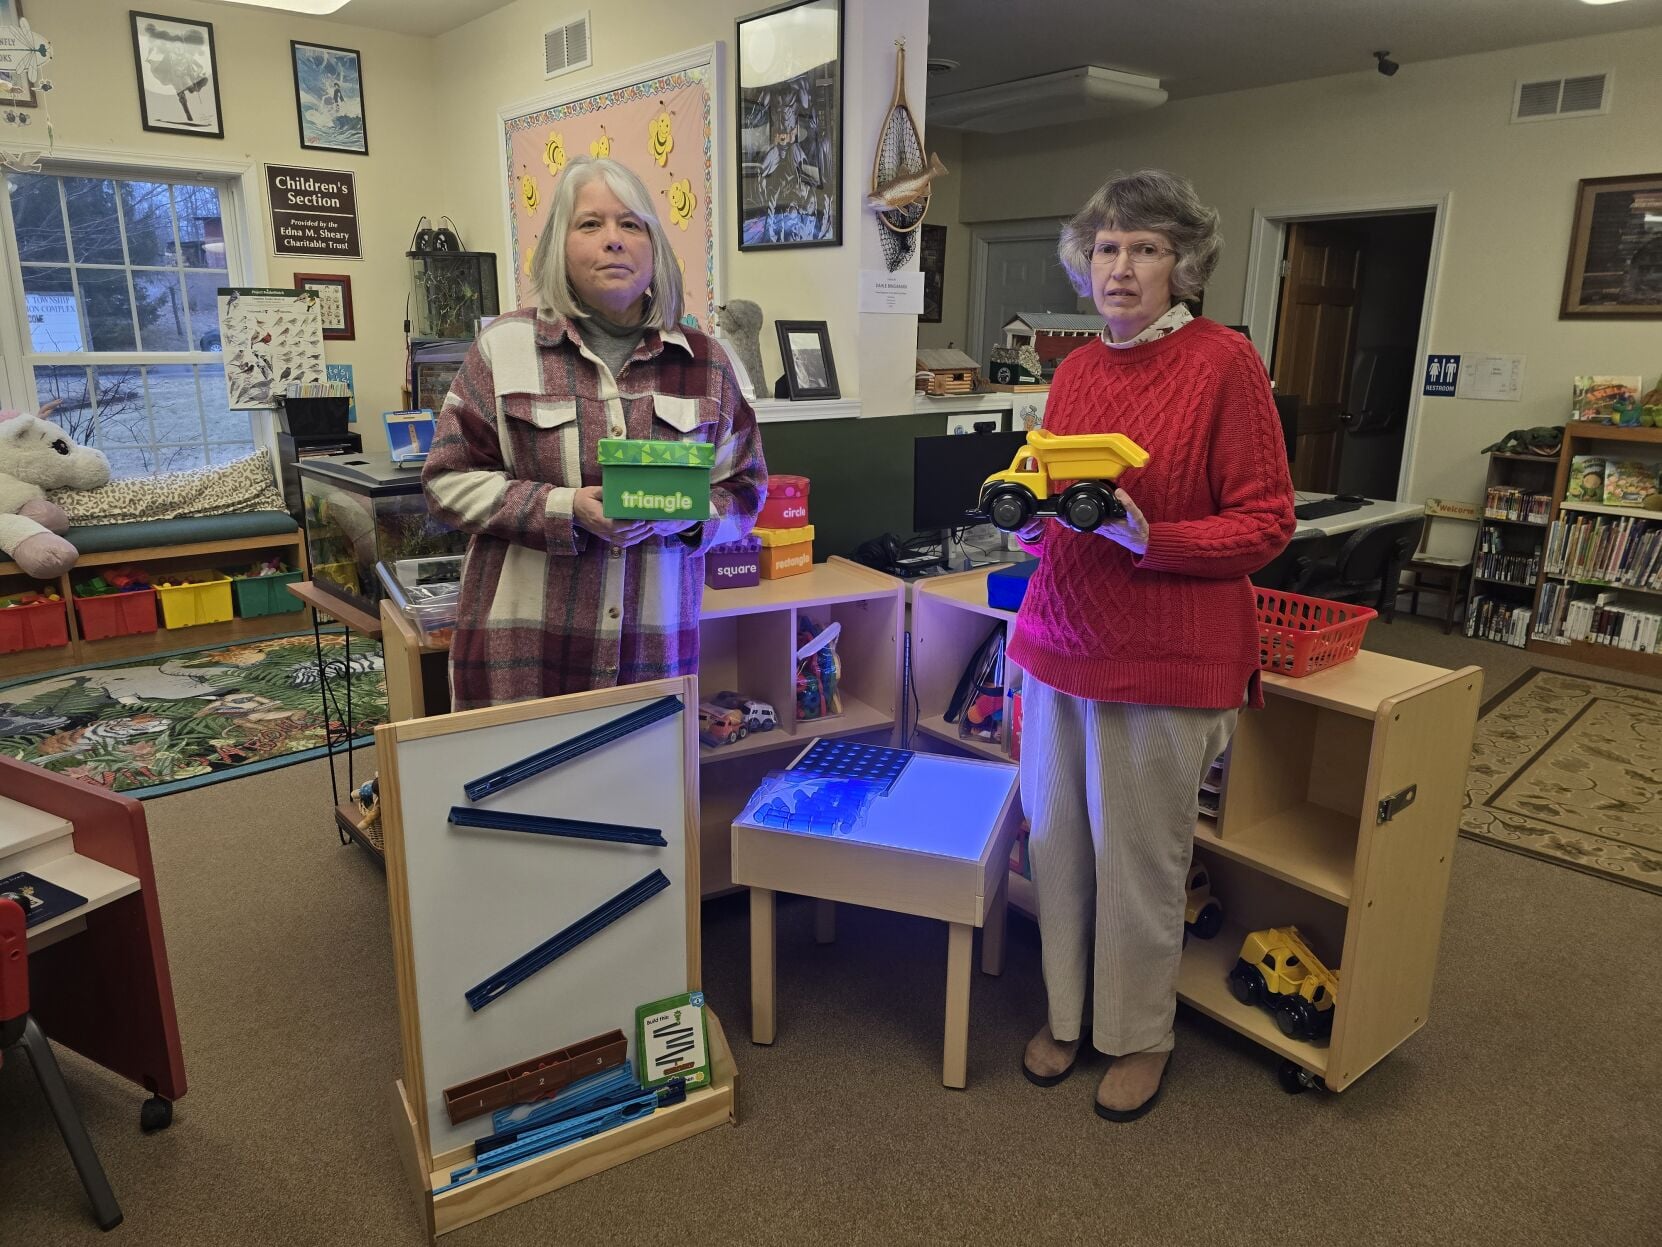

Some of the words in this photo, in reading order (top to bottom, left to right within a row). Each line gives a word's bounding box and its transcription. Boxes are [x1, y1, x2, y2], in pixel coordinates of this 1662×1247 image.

[275, 176, 348, 194] Children's
[287, 191, 340, 208] Section
[291, 219, 318, 227] Provided
[319, 221, 327, 229] by
[280, 227, 303, 236] Edna
[305, 229, 318, 237] M.
[320, 229, 349, 241] Sheary
[284, 238, 327, 248] Charitable
[328, 241, 349, 250] Trust
[33, 296, 70, 304] TOWNSHIP
[621, 490, 693, 513] triangle
[783, 506, 806, 518] circle
[1440, 504, 1475, 515] Welcome
[775, 553, 810, 570] rectangle
[717, 564, 757, 578] square
[646, 1017, 659, 1026] Build
[596, 1057, 603, 1065] 3
[539, 1078, 545, 1086] 2
